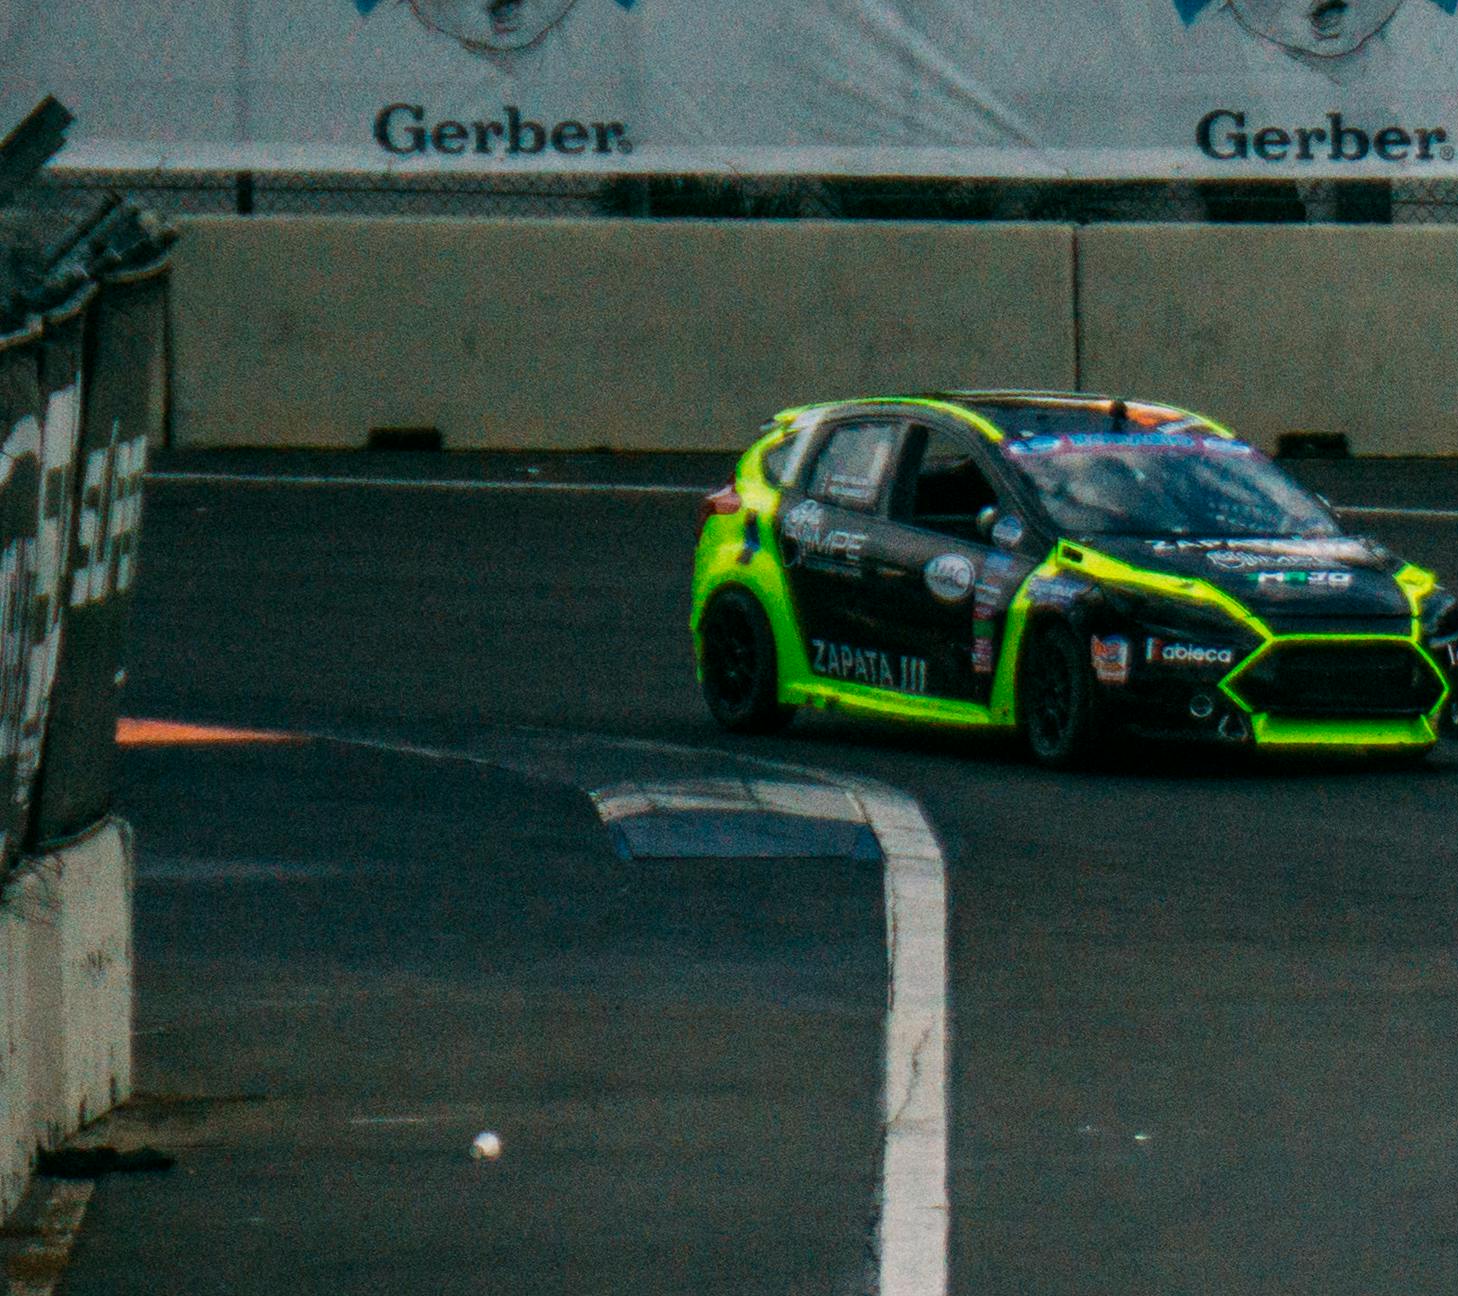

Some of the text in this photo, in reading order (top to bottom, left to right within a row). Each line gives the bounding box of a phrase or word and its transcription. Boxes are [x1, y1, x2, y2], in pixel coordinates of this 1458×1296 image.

[372, 101, 625, 155] Gerber
[1195, 108, 1447, 161] Gerber
[811, 639, 928, 692] ZAPATA III
